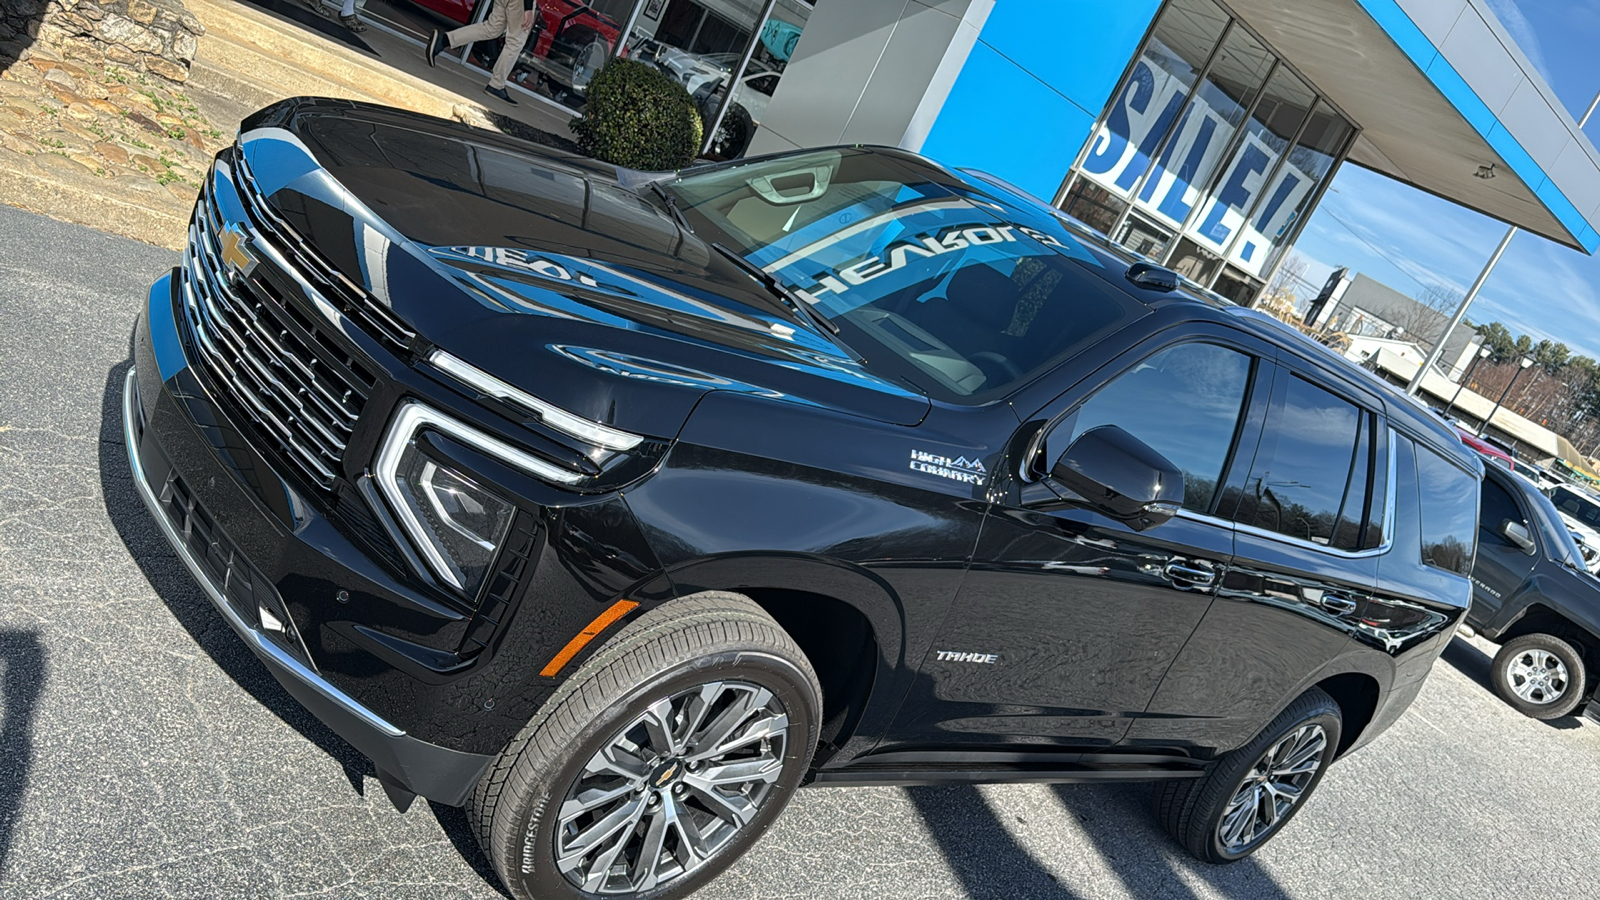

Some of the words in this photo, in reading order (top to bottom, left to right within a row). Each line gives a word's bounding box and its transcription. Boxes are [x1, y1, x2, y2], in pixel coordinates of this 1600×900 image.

[1082, 61, 1300, 263] SALE!
[911, 449, 953, 468] HIGH
[910, 460, 986, 486] COUNTRY
[937, 650, 998, 664] TAHOE
[521, 791, 553, 874] BRIDGESTONE
